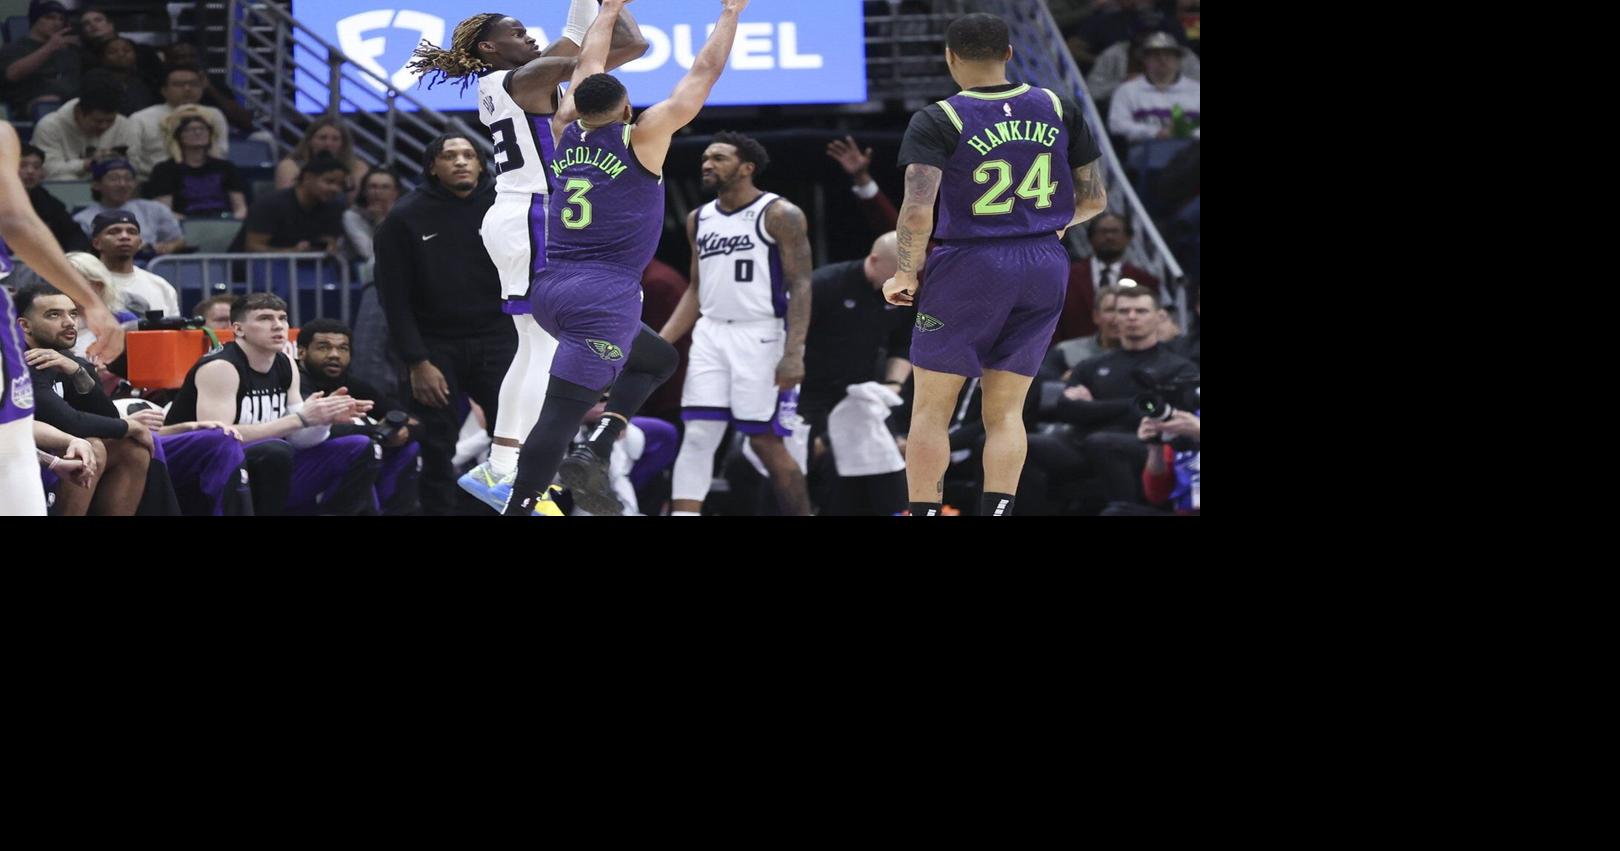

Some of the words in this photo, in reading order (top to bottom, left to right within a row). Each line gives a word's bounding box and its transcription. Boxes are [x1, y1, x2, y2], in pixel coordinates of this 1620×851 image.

[525, 22, 824, 72] DUEL
[967, 120, 1060, 156] HAWKINS
[550, 146, 628, 179] McCOLLUM
[971, 153, 1058, 216] 24
[560, 177, 594, 230] 3
[697, 232, 755, 260] Kings
[735, 259, 754, 283] 0
